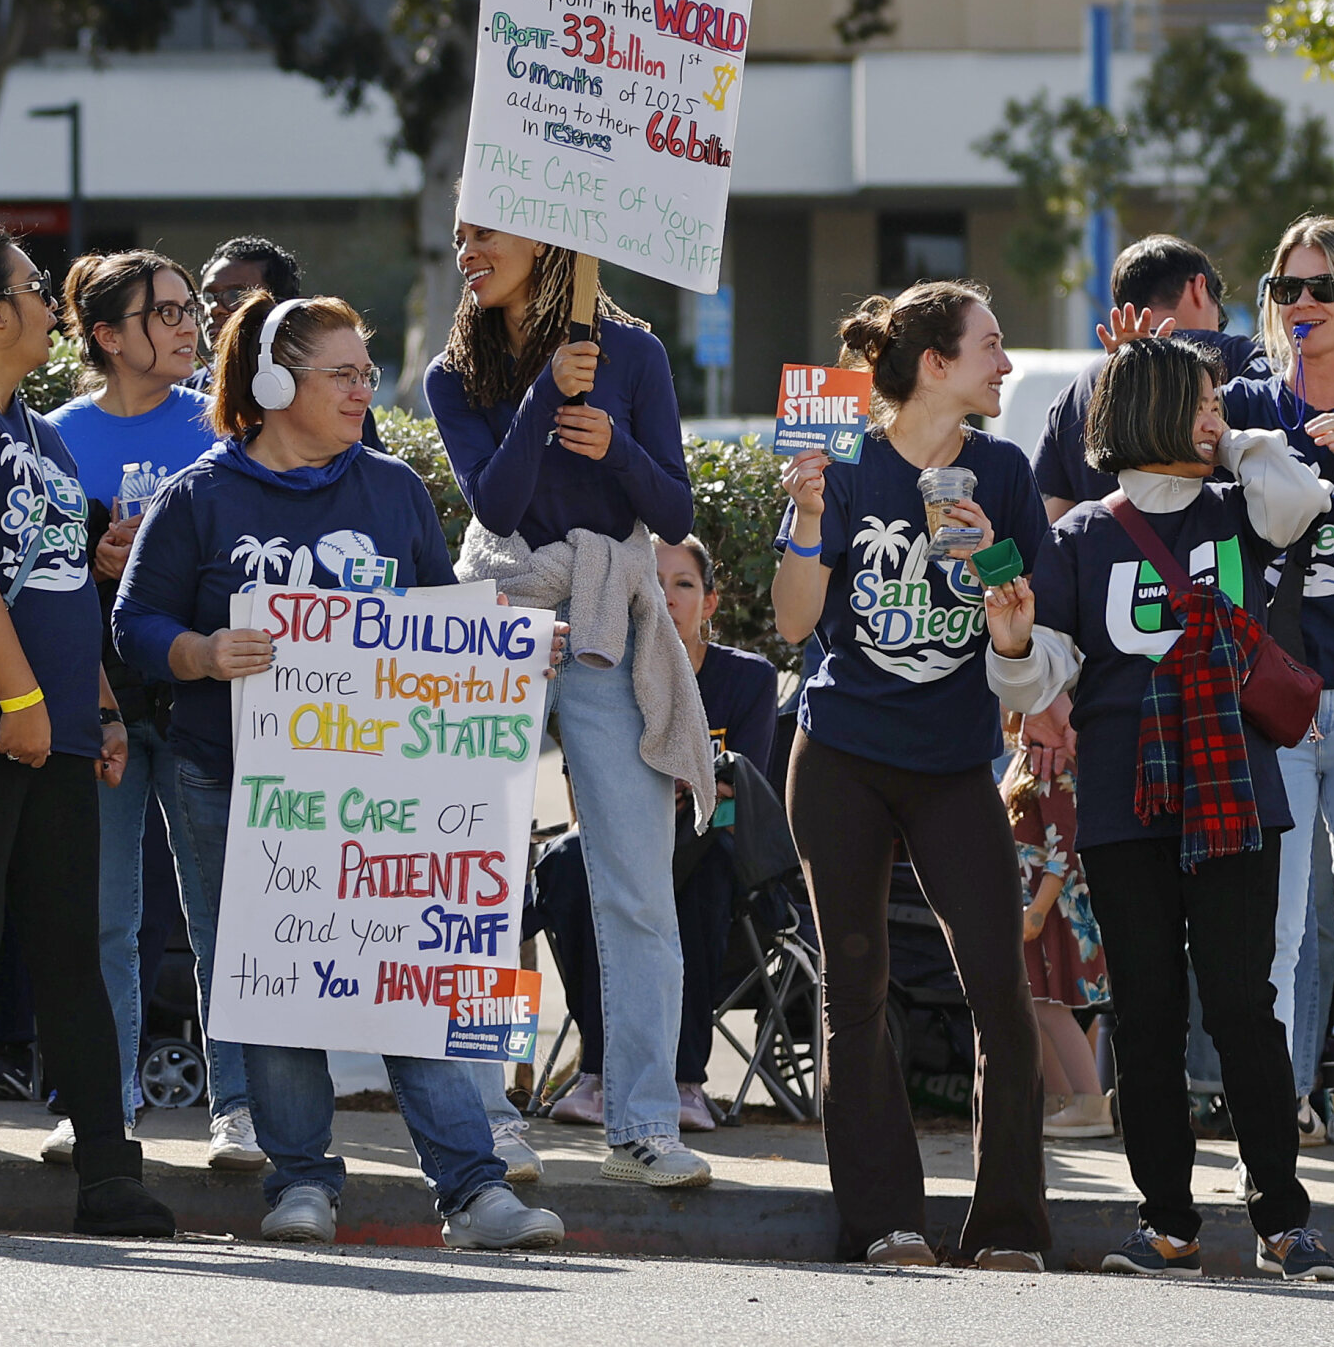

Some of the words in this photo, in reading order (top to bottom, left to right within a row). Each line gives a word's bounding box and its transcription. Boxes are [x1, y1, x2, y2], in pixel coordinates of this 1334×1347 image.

[606, 26, 666, 79] billion
[529, 62, 603, 97] months
[619, 82, 639, 103] of
[645, 86, 700, 114] 2025
[507, 92, 567, 124] adding
[573, 103, 594, 124] to
[596, 107, 641, 137] their
[522, 117, 539, 136] in
[543, 120, 613, 152] reserves
[474, 143, 533, 180] TAKE
[544, 156, 609, 202] CARE
[488, 185, 608, 243] PATIENTS
[617, 233, 652, 256] and
[664, 230, 720, 274] STAFF
[785, 368, 827, 398] ULP
[784, 396, 859, 426] STRIKE
[851, 572, 929, 611] San
[263, 593, 351, 643] STOP
[353, 597, 536, 660] BUILDING
[871, 606, 986, 644] Diego
[275, 664, 358, 695] more
[374, 657, 531, 708] Hospitals
[252, 705, 278, 740] in
[289, 702, 399, 752] Other
[241, 775, 327, 831] TAKE
[338, 787, 421, 834] CARE
[437, 803, 489, 837] OF
[338, 840, 510, 907] PATIENTS
[274, 912, 340, 945] and
[351, 918, 411, 956] your
[418, 905, 510, 957] STAFF
[230, 953, 301, 999] that
[374, 961, 454, 1006] HAVE
[457, 968, 498, 998] ULP
[456, 995, 531, 1028] STRIKE
